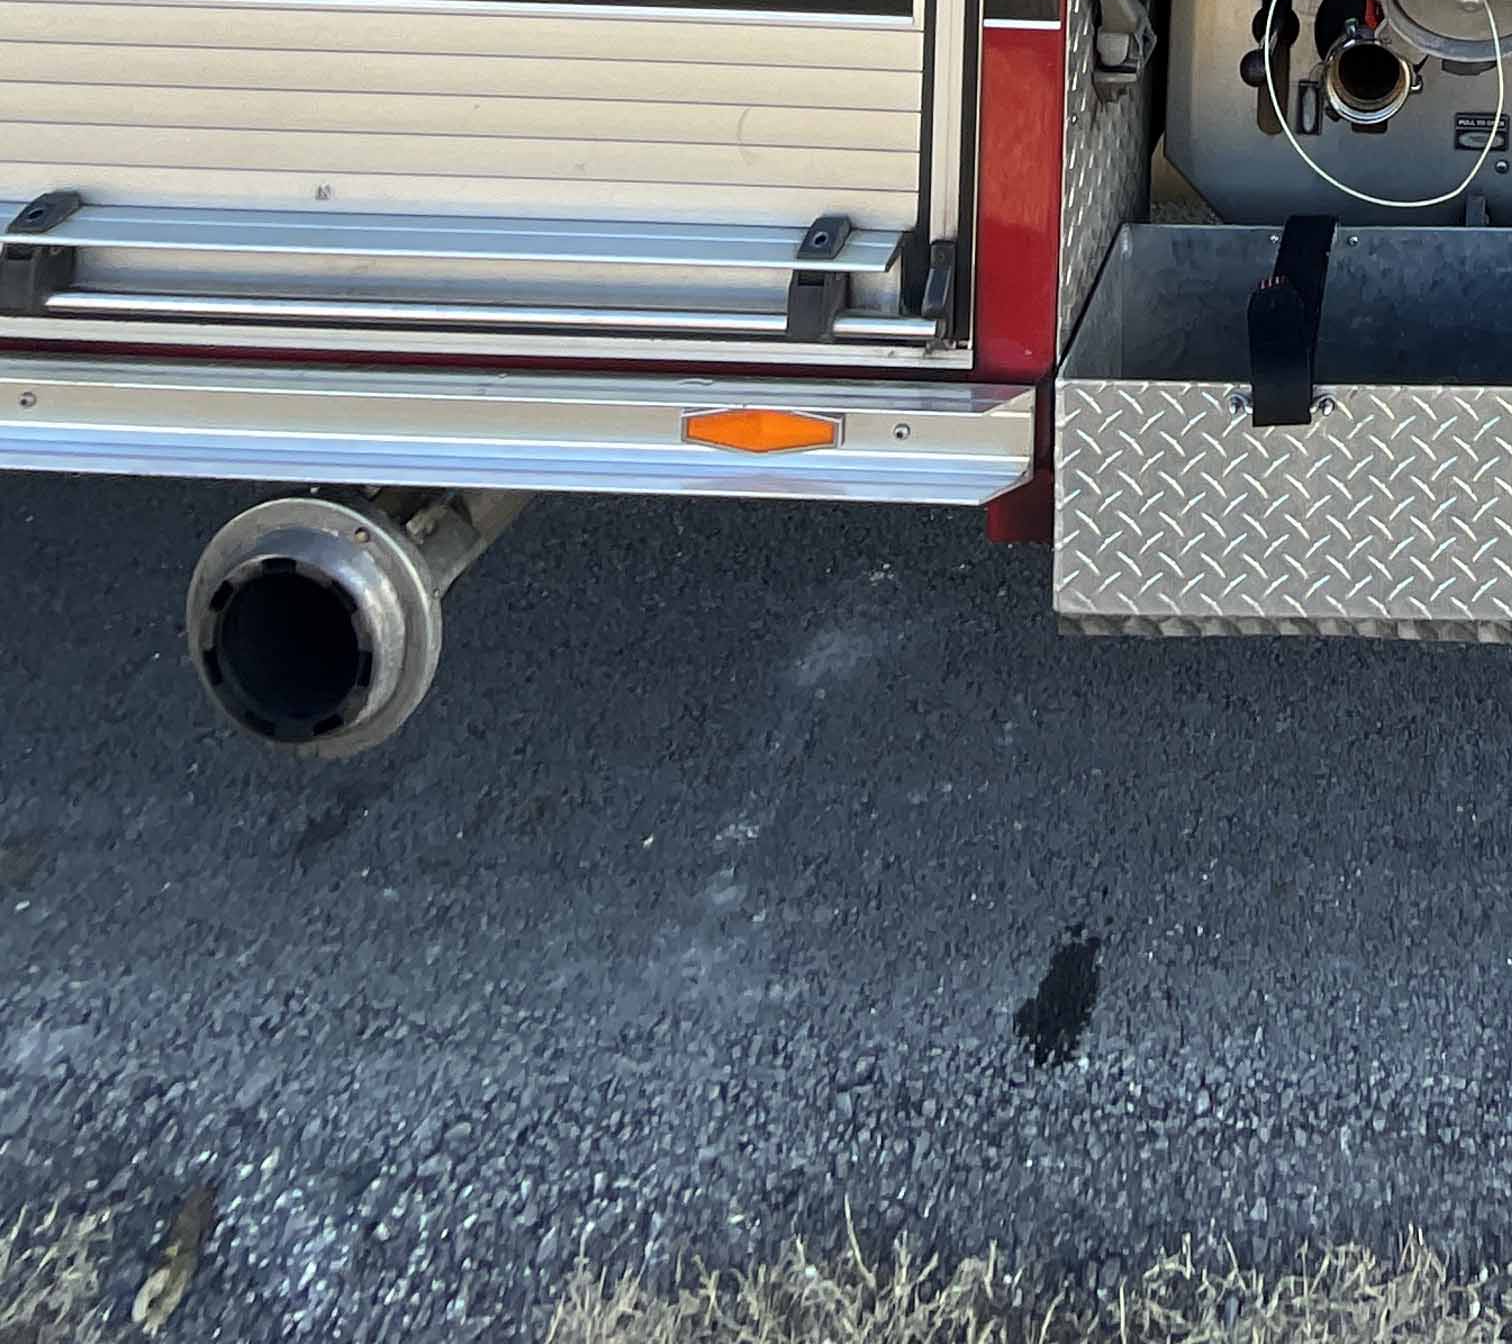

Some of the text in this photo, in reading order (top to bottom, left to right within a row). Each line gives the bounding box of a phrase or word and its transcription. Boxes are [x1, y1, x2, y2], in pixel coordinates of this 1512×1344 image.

[1458, 119, 1505, 127] PULL TO OPN
